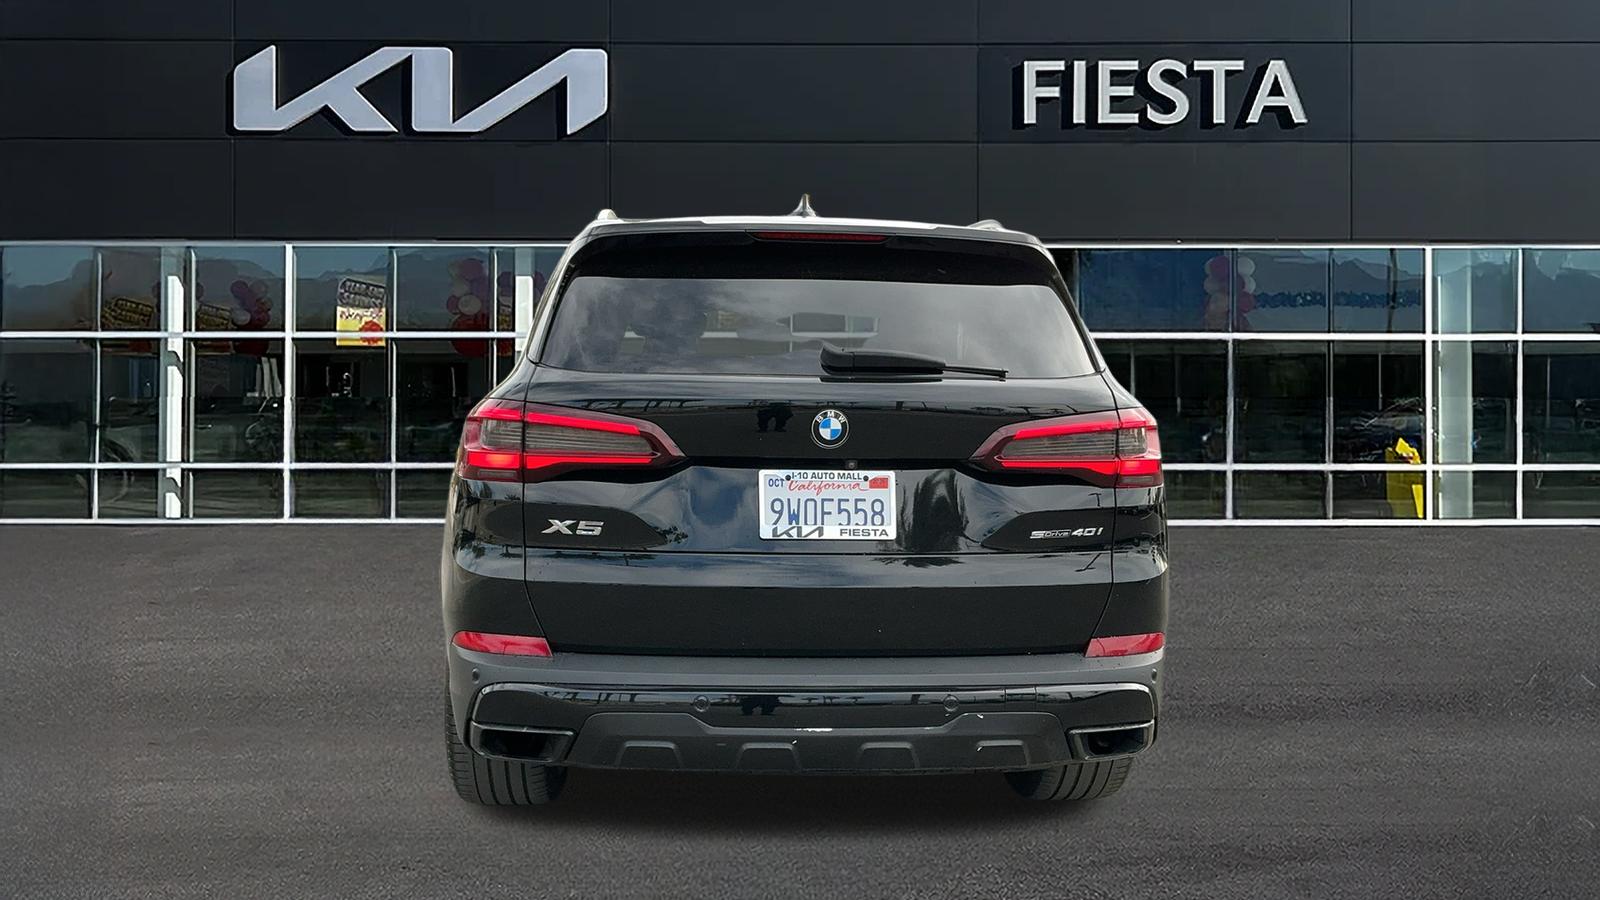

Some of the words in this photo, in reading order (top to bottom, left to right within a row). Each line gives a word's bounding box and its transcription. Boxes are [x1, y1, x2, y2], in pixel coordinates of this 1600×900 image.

[233, 44, 609, 135] KIA
[1022, 58, 1309, 125] FIESTA
[815, 411, 846, 424] BMW
[768, 478, 785, 487] OCT
[791, 472, 808, 480] I-10
[810, 472, 835, 480] AUTO
[837, 472, 862, 480] MALL
[788, 480, 869, 496] California
[541, 519, 605, 536] X5
[839, 528, 889, 537] FIESTA
